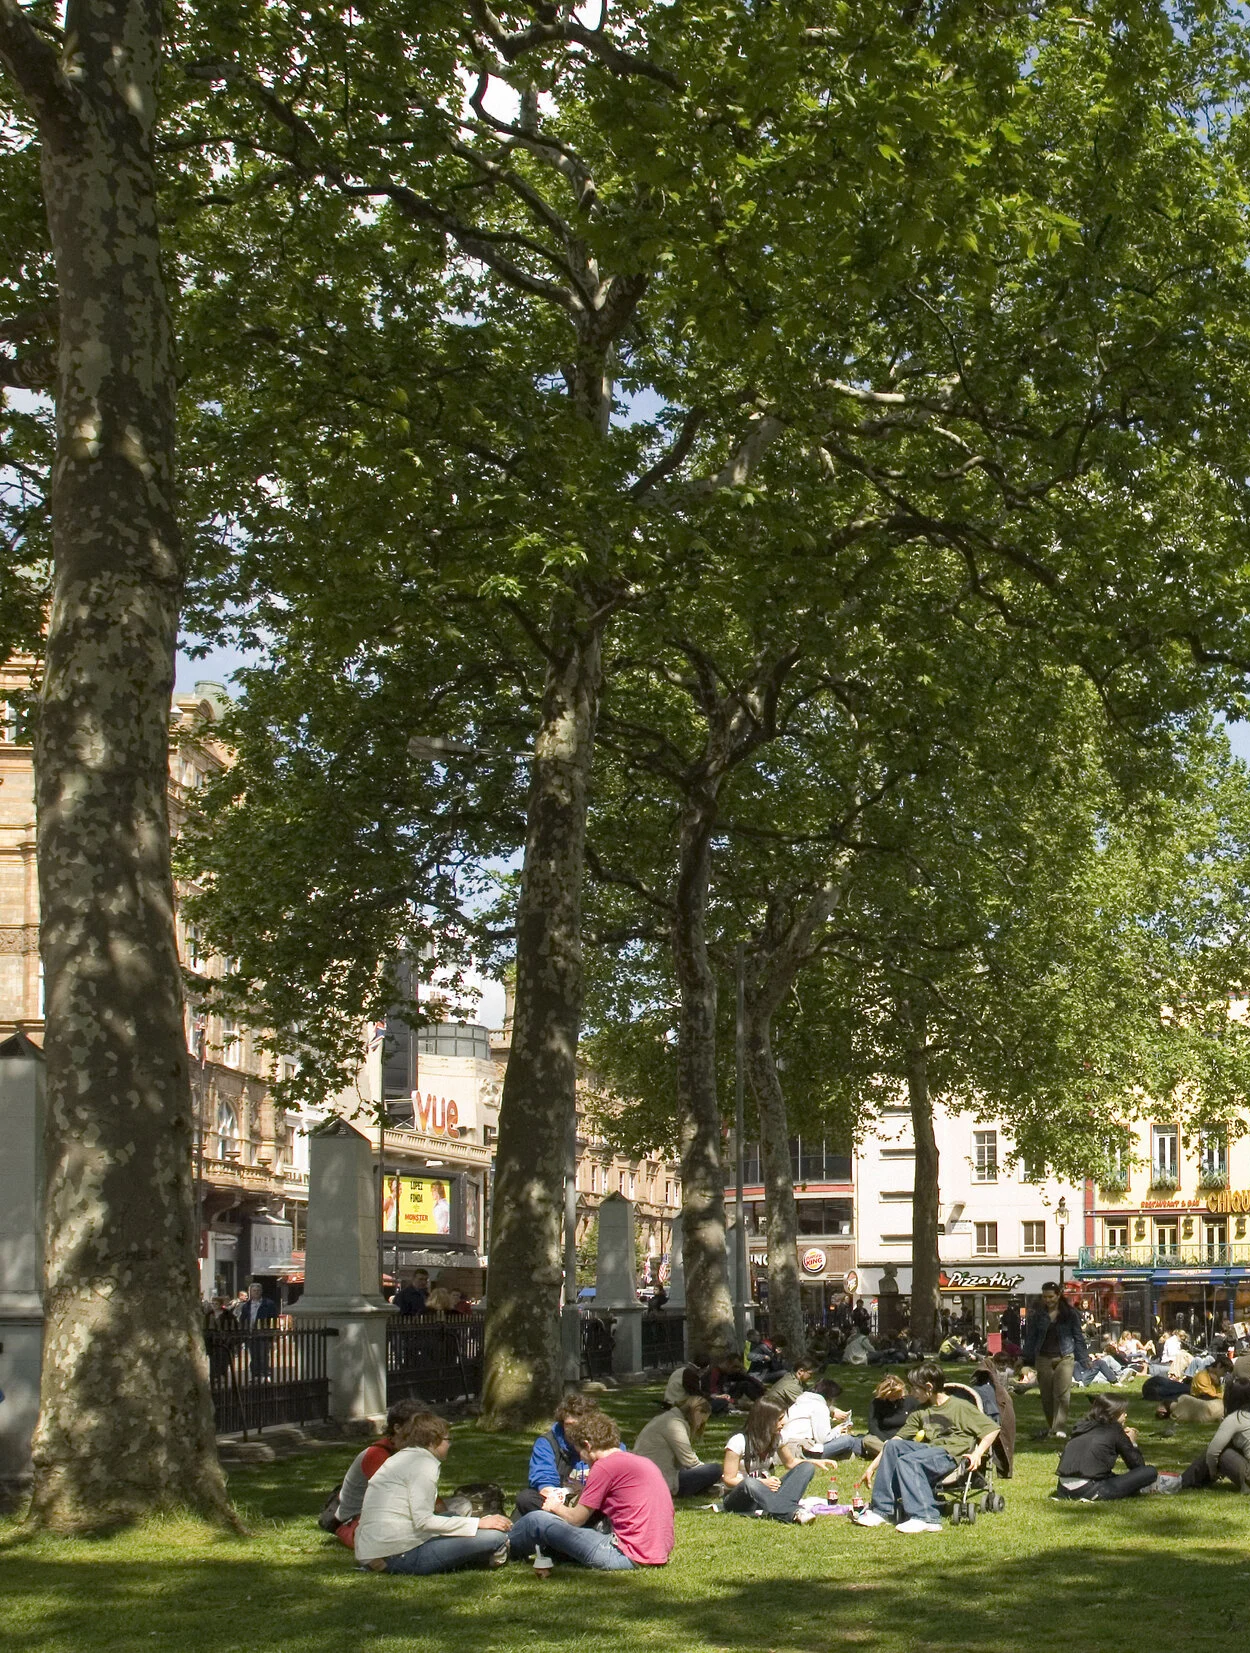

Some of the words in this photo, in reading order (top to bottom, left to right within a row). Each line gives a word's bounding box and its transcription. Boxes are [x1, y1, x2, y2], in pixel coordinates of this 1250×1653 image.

[1187, 1199, 1200, 1208] BAR
[405, 1213, 428, 1221] MONSTER
[806, 1257, 823, 1267] KING
[948, 1271, 988, 1287] Pizza
[989, 1272, 1024, 1287] Hut
